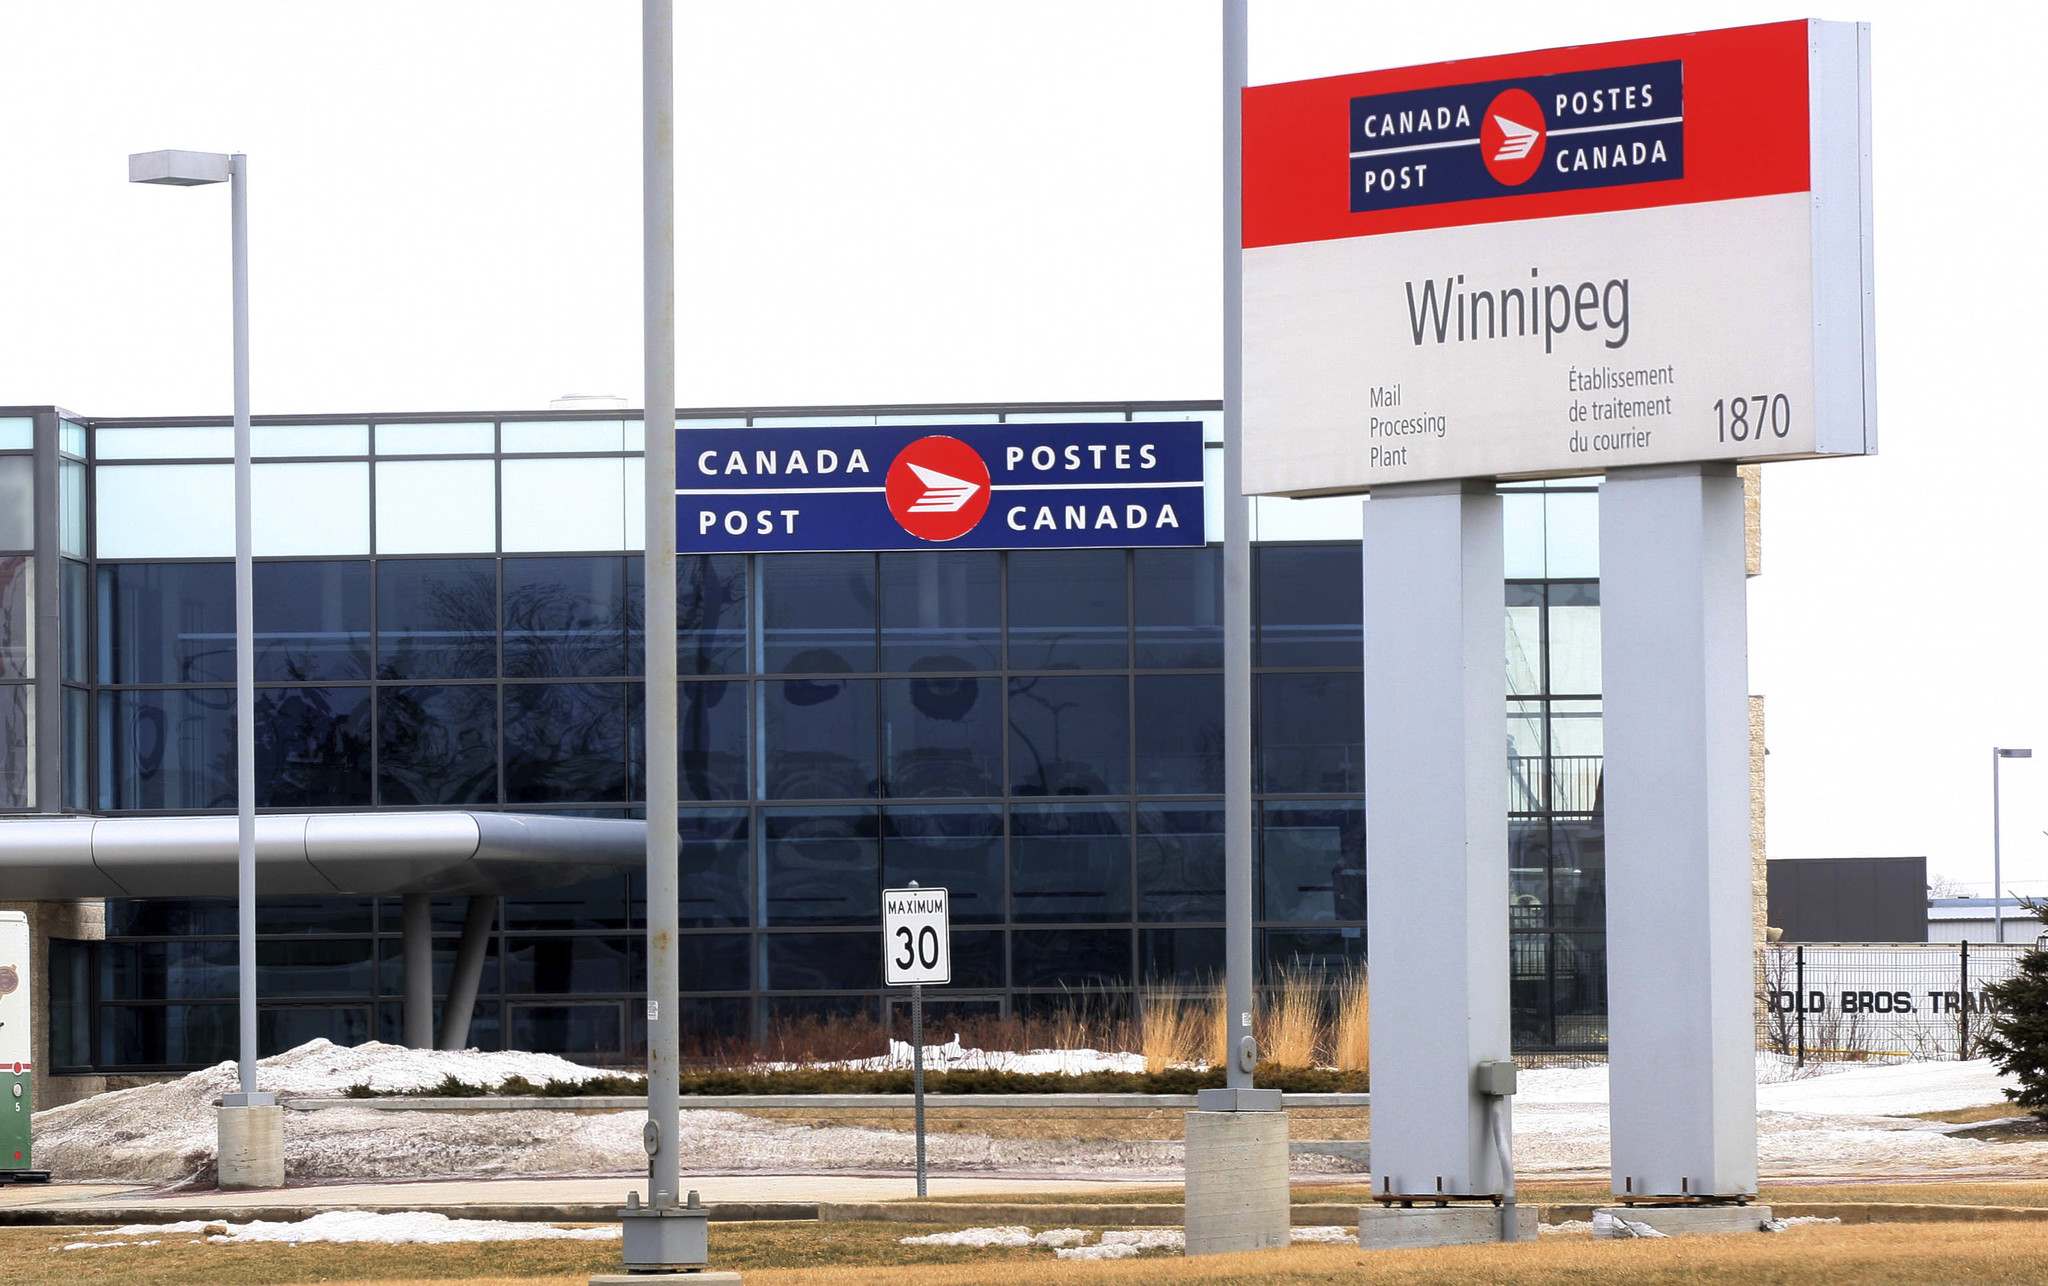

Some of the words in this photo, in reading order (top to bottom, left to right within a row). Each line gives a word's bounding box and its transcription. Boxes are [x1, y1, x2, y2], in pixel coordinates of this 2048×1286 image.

[1556, 84, 1653, 117] POSTES
[1364, 104, 1472, 138] CANADA
[1556, 140, 1667, 173] CANADA
[1365, 164, 1427, 193] POST
[1405, 267, 1630, 355] Winnipeg
[1569, 364, 1675, 392] Établissement
[1370, 383, 1402, 409] Mail
[1568, 399, 1588, 423] de
[1591, 395, 1672, 421] traitement
[1370, 411, 1446, 438] Processing
[1713, 393, 1791, 443] 1870
[1569, 429, 1588, 453] du
[1593, 426, 1652, 452] courrier
[698, 448, 870, 476] CANADA
[1006, 444, 1157, 471] POSTES
[1370, 444, 1408, 468] Plant
[699, 509, 800, 536] POST
[1006, 504, 1179, 531] CANADA
[888, 899, 943, 915] MAXIMUM
[895, 925, 939, 971] 30
[1841, 990, 1918, 1014] BROS.
[15, 1101, 21, 1112] 5
